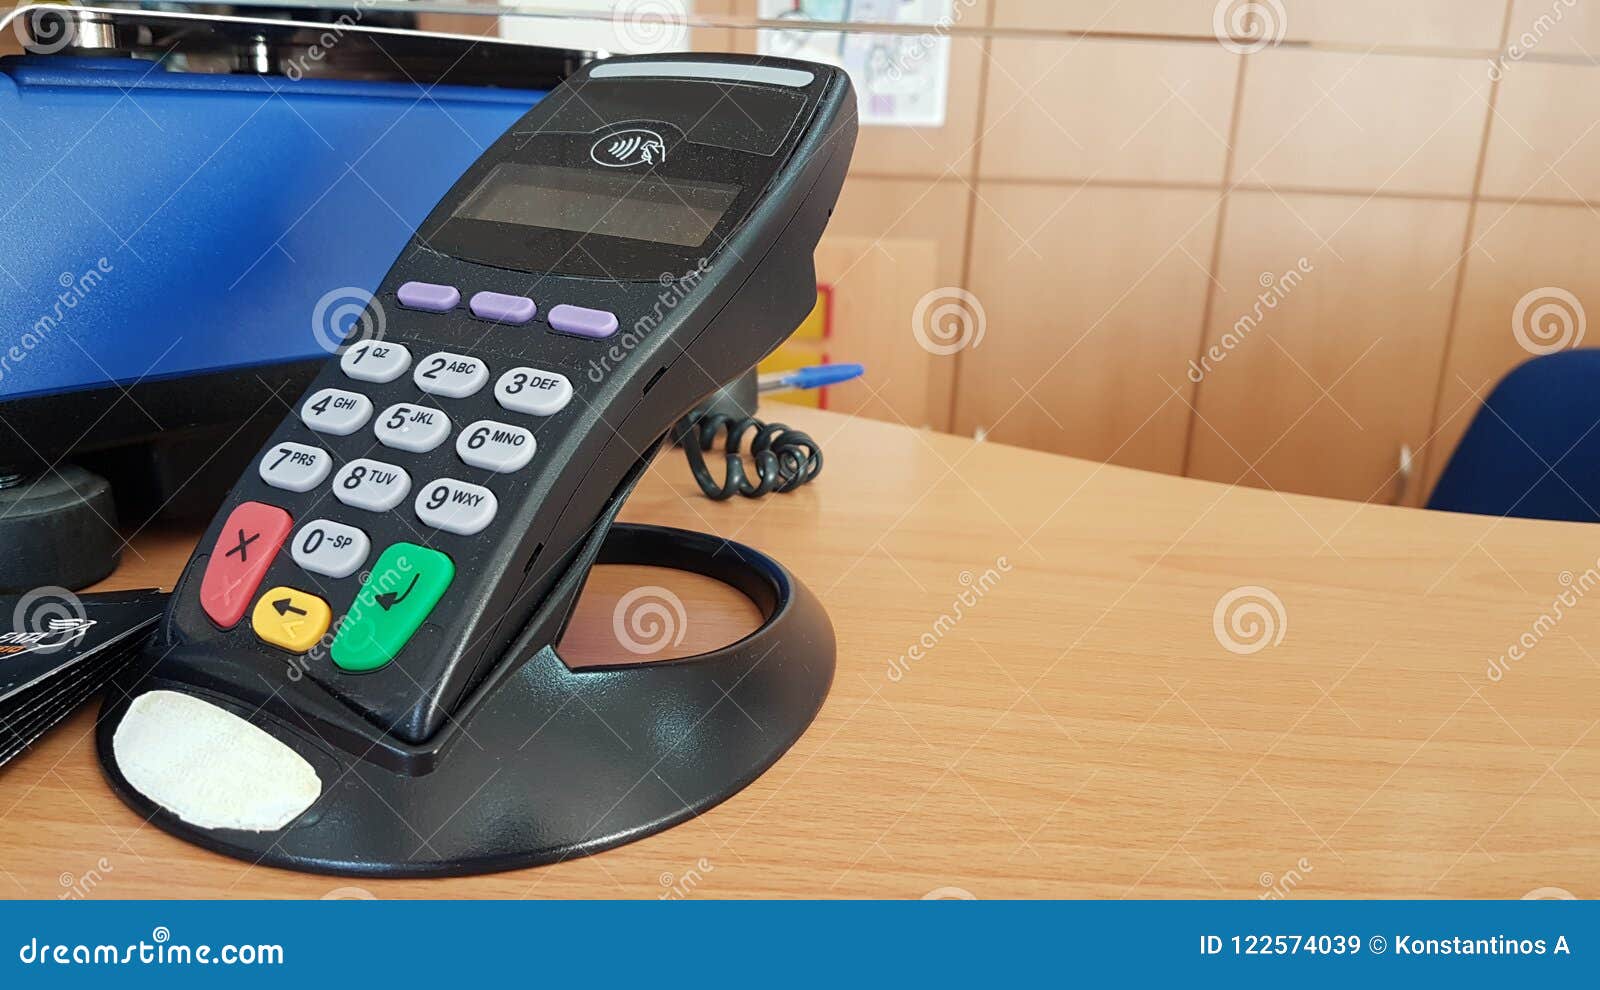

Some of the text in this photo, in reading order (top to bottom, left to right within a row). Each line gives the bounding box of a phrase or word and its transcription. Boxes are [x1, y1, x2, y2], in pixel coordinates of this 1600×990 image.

[355, 346, 390, 364] 1 QZ
[423, 358, 475, 379] 2 ABC
[505, 374, 559, 394] 3 DEF
[311, 395, 357, 416] 4 GHI
[386, 408, 433, 429] 5 JKL
[467, 428, 525, 449] 6 MNO
[269, 448, 316, 470] 7 PRS
[343, 466, 397, 489] 8 TUV
[426, 485, 484, 509] 9 WXY
[302, 529, 324, 554] 0
